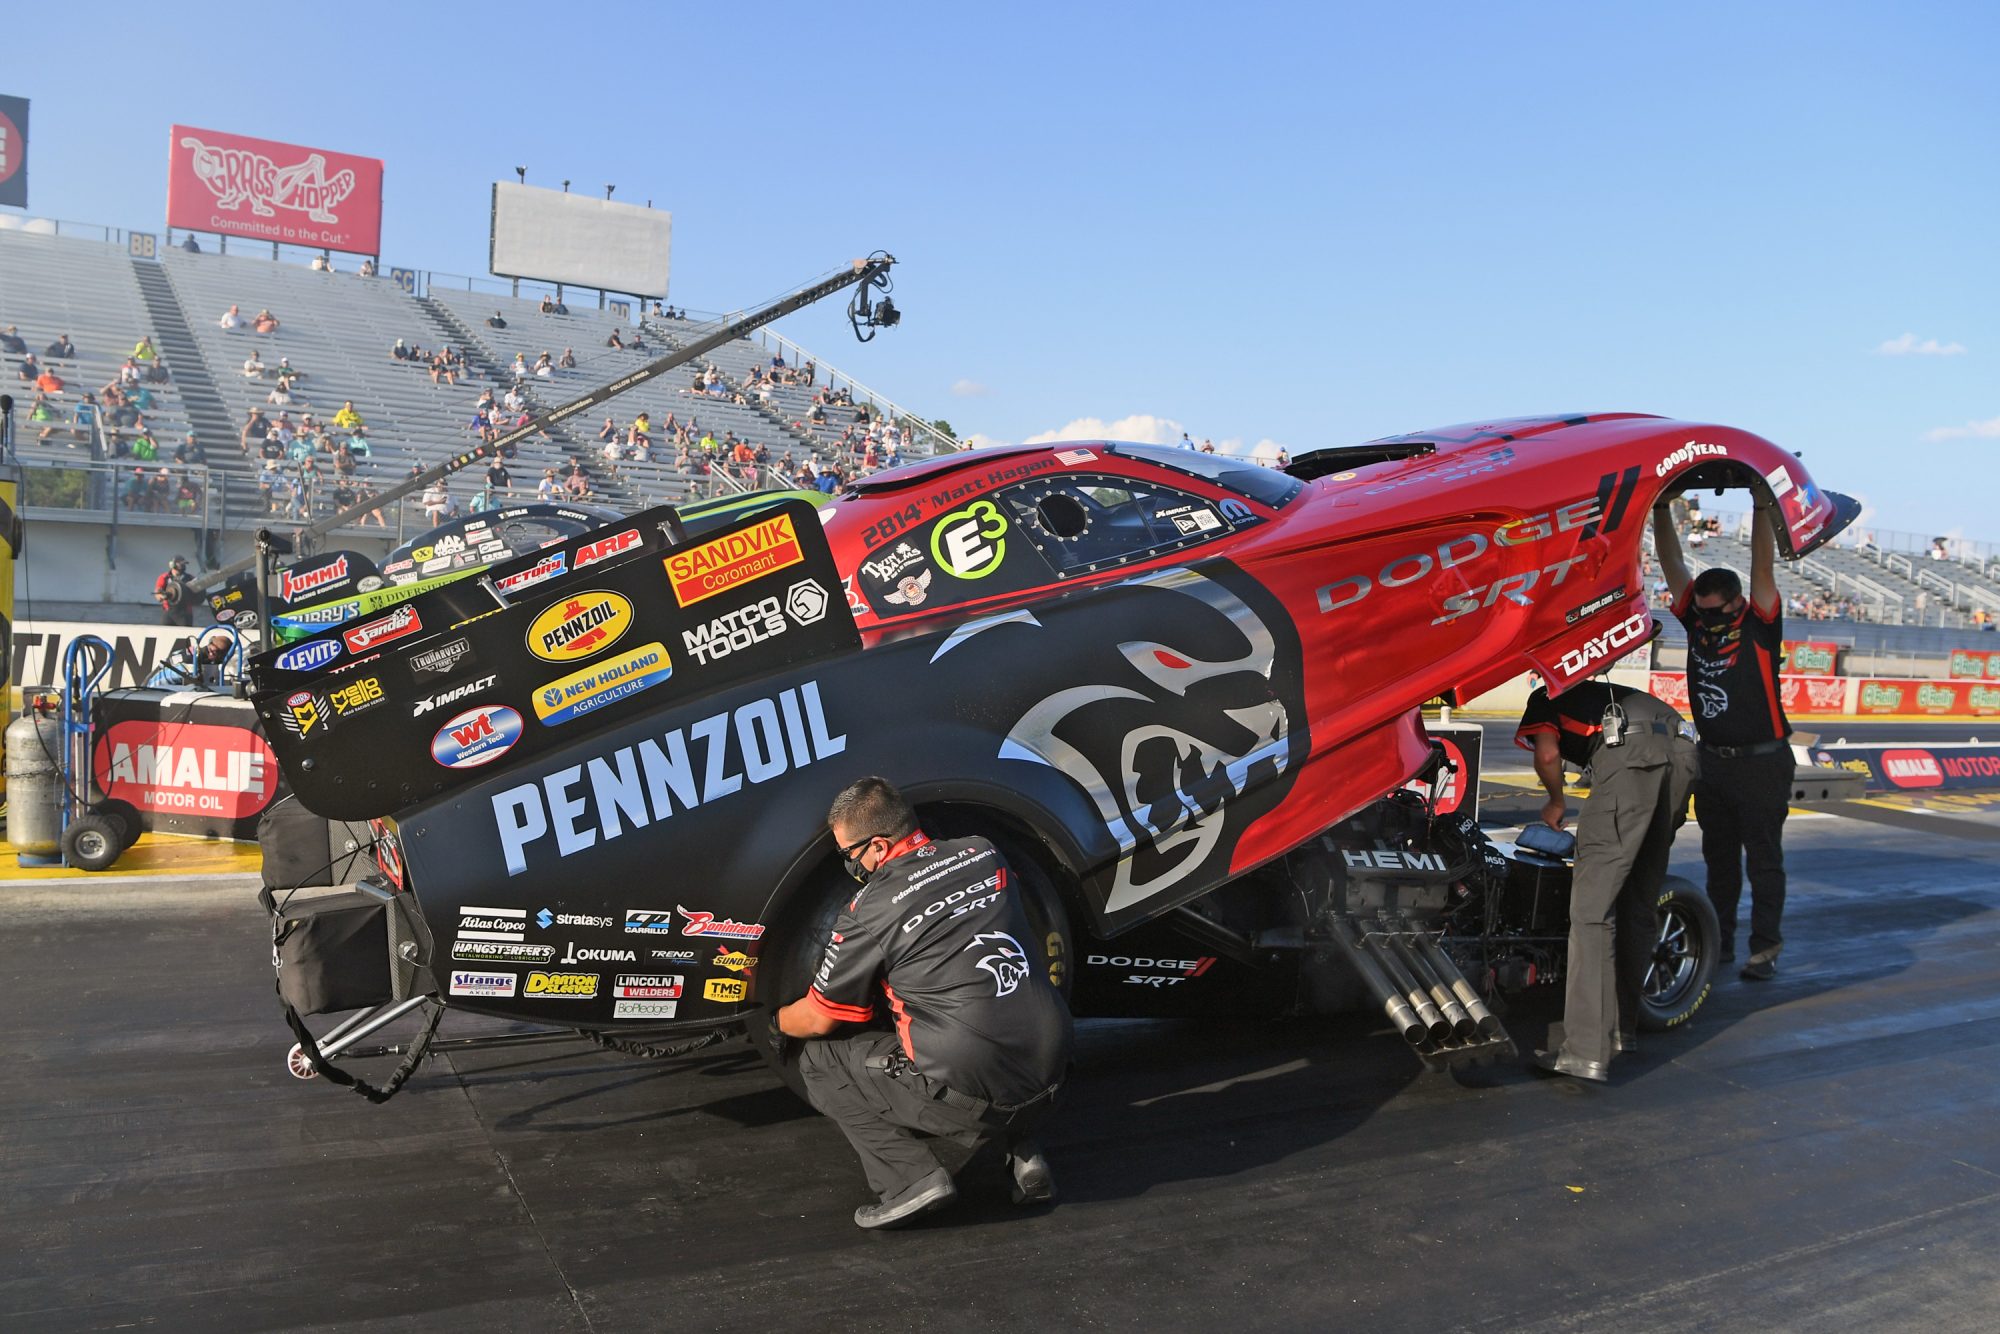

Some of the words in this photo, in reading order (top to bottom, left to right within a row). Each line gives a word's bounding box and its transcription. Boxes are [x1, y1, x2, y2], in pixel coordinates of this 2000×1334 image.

[210, 215, 280, 236] Committed
[283, 229, 295, 238] to
[298, 230, 318, 241] the
[321, 231, 346, 244] Cut.
[131, 233, 155, 258] BB
[1655, 440, 1728, 477] GOODYEAR
[931, 481, 987, 510] Matt
[988, 457, 1055, 485] Hagan
[1164, 504, 1192, 516] IMPACT
[574, 528, 639, 568] ARP
[670, 518, 792, 580] SANDVIK
[1315, 496, 1604, 613] DODGE
[495, 559, 562, 590] VICTORY
[702, 552, 777, 590] Coromant
[861, 553, 898, 578] TWIN
[880, 548, 921, 582] PALMS
[293, 590, 317, 604] RACING
[317, 578, 351, 595] EQUIPMENT
[386, 579, 455, 602] DIVERSIF
[1431, 553, 1589, 627] SRT
[1580, 594, 1613, 617] dsmpm.com
[349, 613, 414, 646] Sander
[542, 600, 617, 654] PENNZOIL
[681, 596, 781, 650] MATCO
[688, 613, 787, 666] TOOLS
[1555, 613, 1646, 677] DAYCO
[276, 640, 339, 671] CLEVITE
[413, 640, 466, 668] TRUHARVEST
[564, 676, 596, 698] NEW
[598, 652, 659, 685] HOLLAND
[354, 703, 371, 712] RACING
[370, 697, 386, 706] SERIES
[435, 674, 497, 708] IMPACT
[573, 678, 645, 715] AGRICULTURE
[451, 713, 495, 747] wt
[456, 742, 487, 760] Western
[487, 732, 505, 745] Tech
[107, 743, 265, 793] AMALIE
[491, 680, 847, 877] PENNZOIL
[1886, 758, 1940, 777] AMALIE
[144, 791, 195, 808] MOTOR
[199, 795, 223, 810] OIL
[1459, 818, 1474, 834] MSD
[1341, 850, 1447, 871] HEMI
[1484, 855, 1506, 866] MSD
[891, 850, 992, 904] @dodgemoparmotorsports
[902, 875, 1002, 934] DODGE
[949, 891, 1001, 919] SRT
[458, 916, 493, 930] Atlas
[493, 918, 526, 932] Copco
[556, 914, 613, 929] stratasys
[624, 927, 669, 935] CARRILLO
[454, 942, 551, 957] HANGSTERFER'S
[576, 949, 637, 962] OKUMA
[651, 950, 695, 958] TREND
[714, 956, 757, 967] SUNOCO
[1087, 955, 1198, 970] DODGE
[454, 973, 513, 986] Strange
[545, 984, 597, 995] SLEEVES
[618, 976, 672, 987] LINCOLN
[629, 988, 675, 997] WELDERS
[711, 982, 742, 995] TMS
[1122, 975, 1186, 988] SRT
